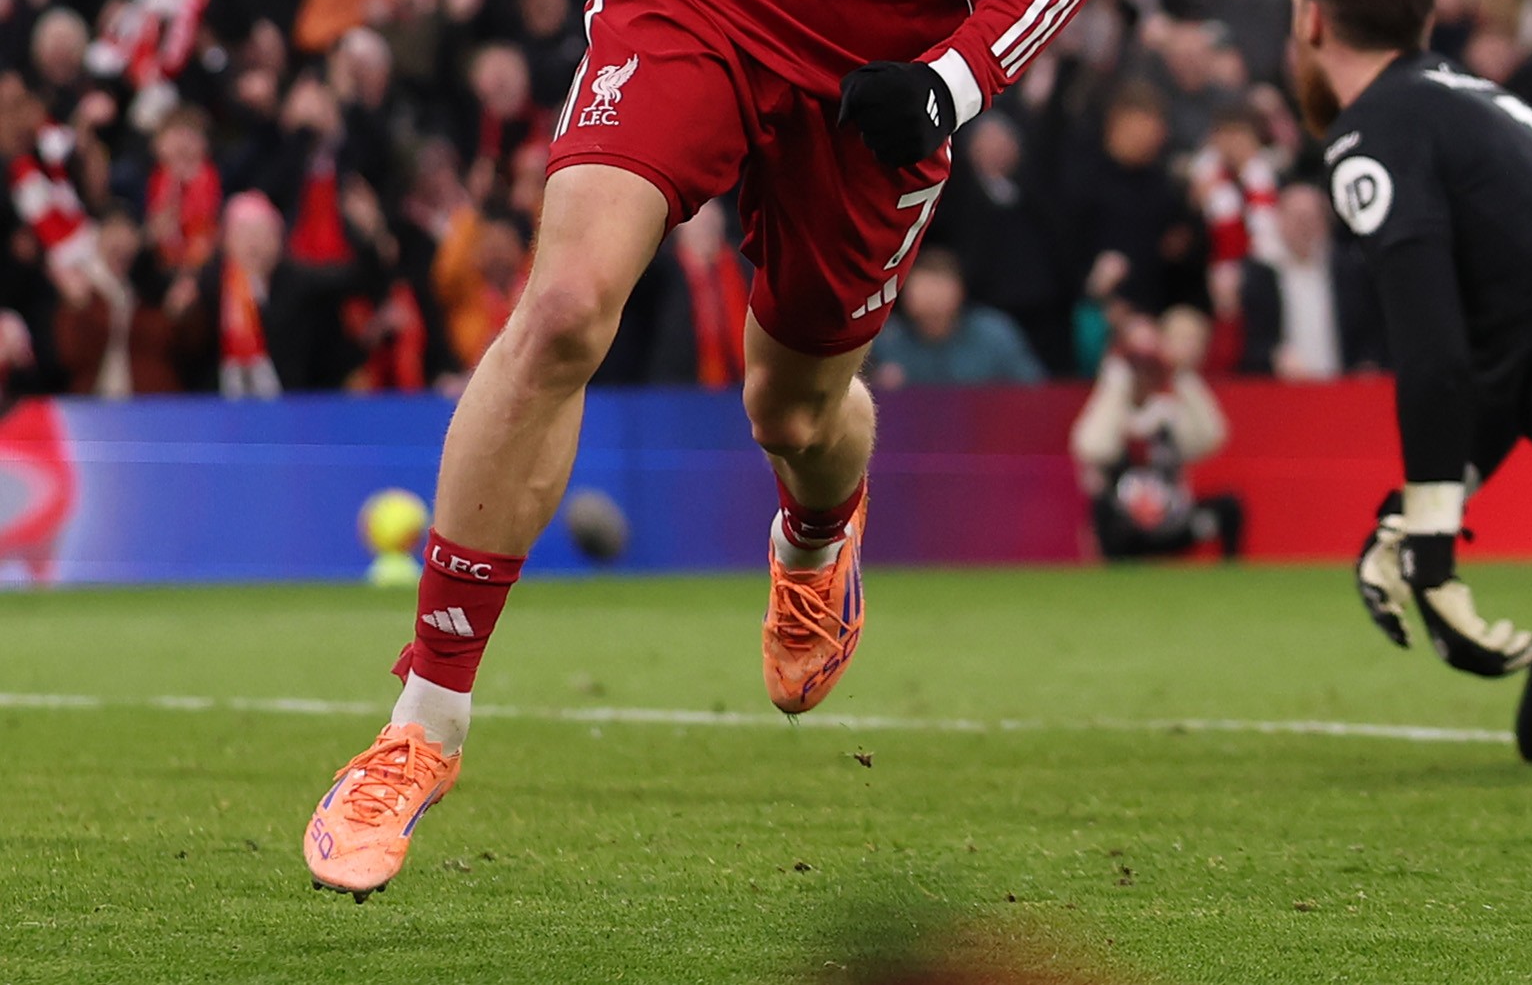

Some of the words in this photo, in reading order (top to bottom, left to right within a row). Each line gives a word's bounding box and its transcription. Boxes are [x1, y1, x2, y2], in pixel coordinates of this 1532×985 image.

[577, 110, 619, 127] L.F.C.
[883, 179, 946, 271] 7
[431, 545, 492, 580] LFC
